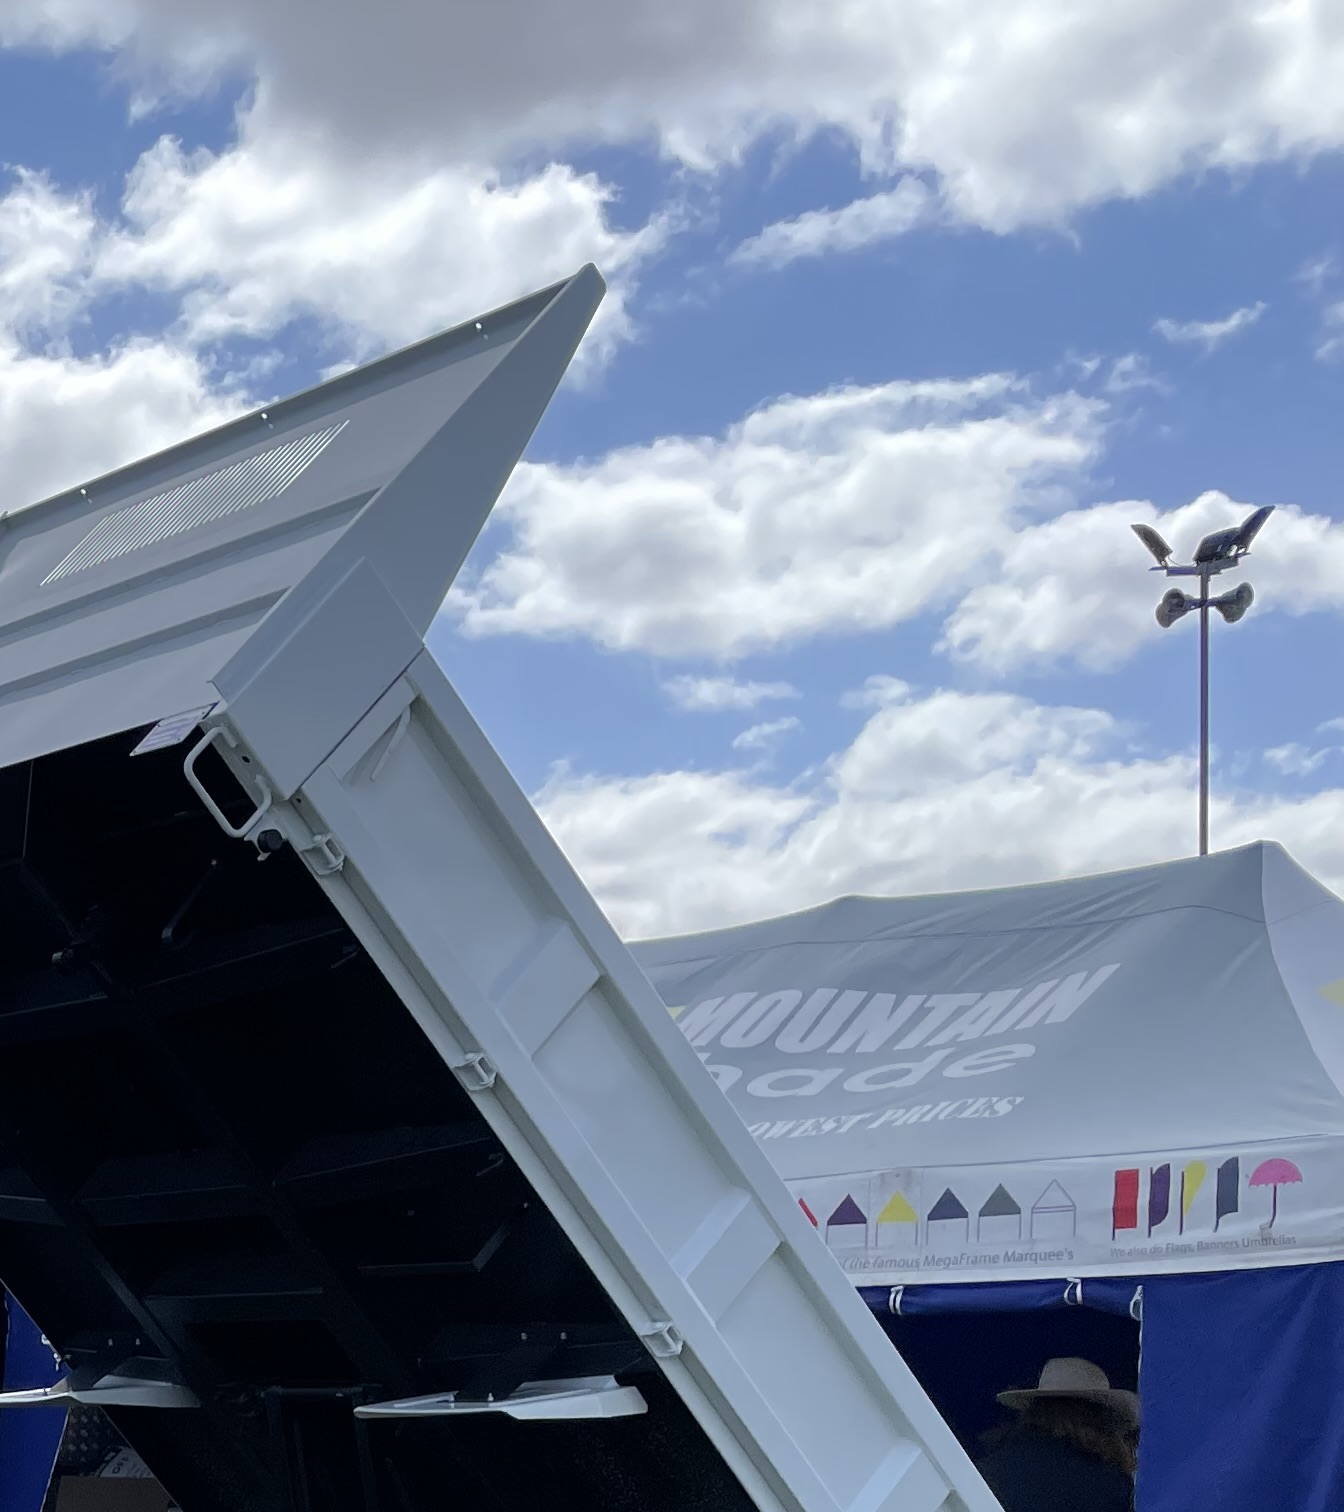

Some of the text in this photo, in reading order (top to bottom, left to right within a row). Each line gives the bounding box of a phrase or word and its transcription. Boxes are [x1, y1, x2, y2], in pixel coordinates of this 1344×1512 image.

[677, 963, 1121, 1054] MOUNTAIN
[698, 1043, 1036, 1098] hade
[748, 1096, 1025, 1140] OWEST PRICES
[850, 1256, 871, 1270] the
[872, 1254, 921, 1270] famous
[923, 1251, 1000, 1269] MegaFrame
[1003, 1247, 1074, 1264] Marquee's
[1149, 1244, 1162, 1254] do
[1196, 1241, 1240, 1251] Banners
[1242, 1235, 1297, 1248] Umbrellas
